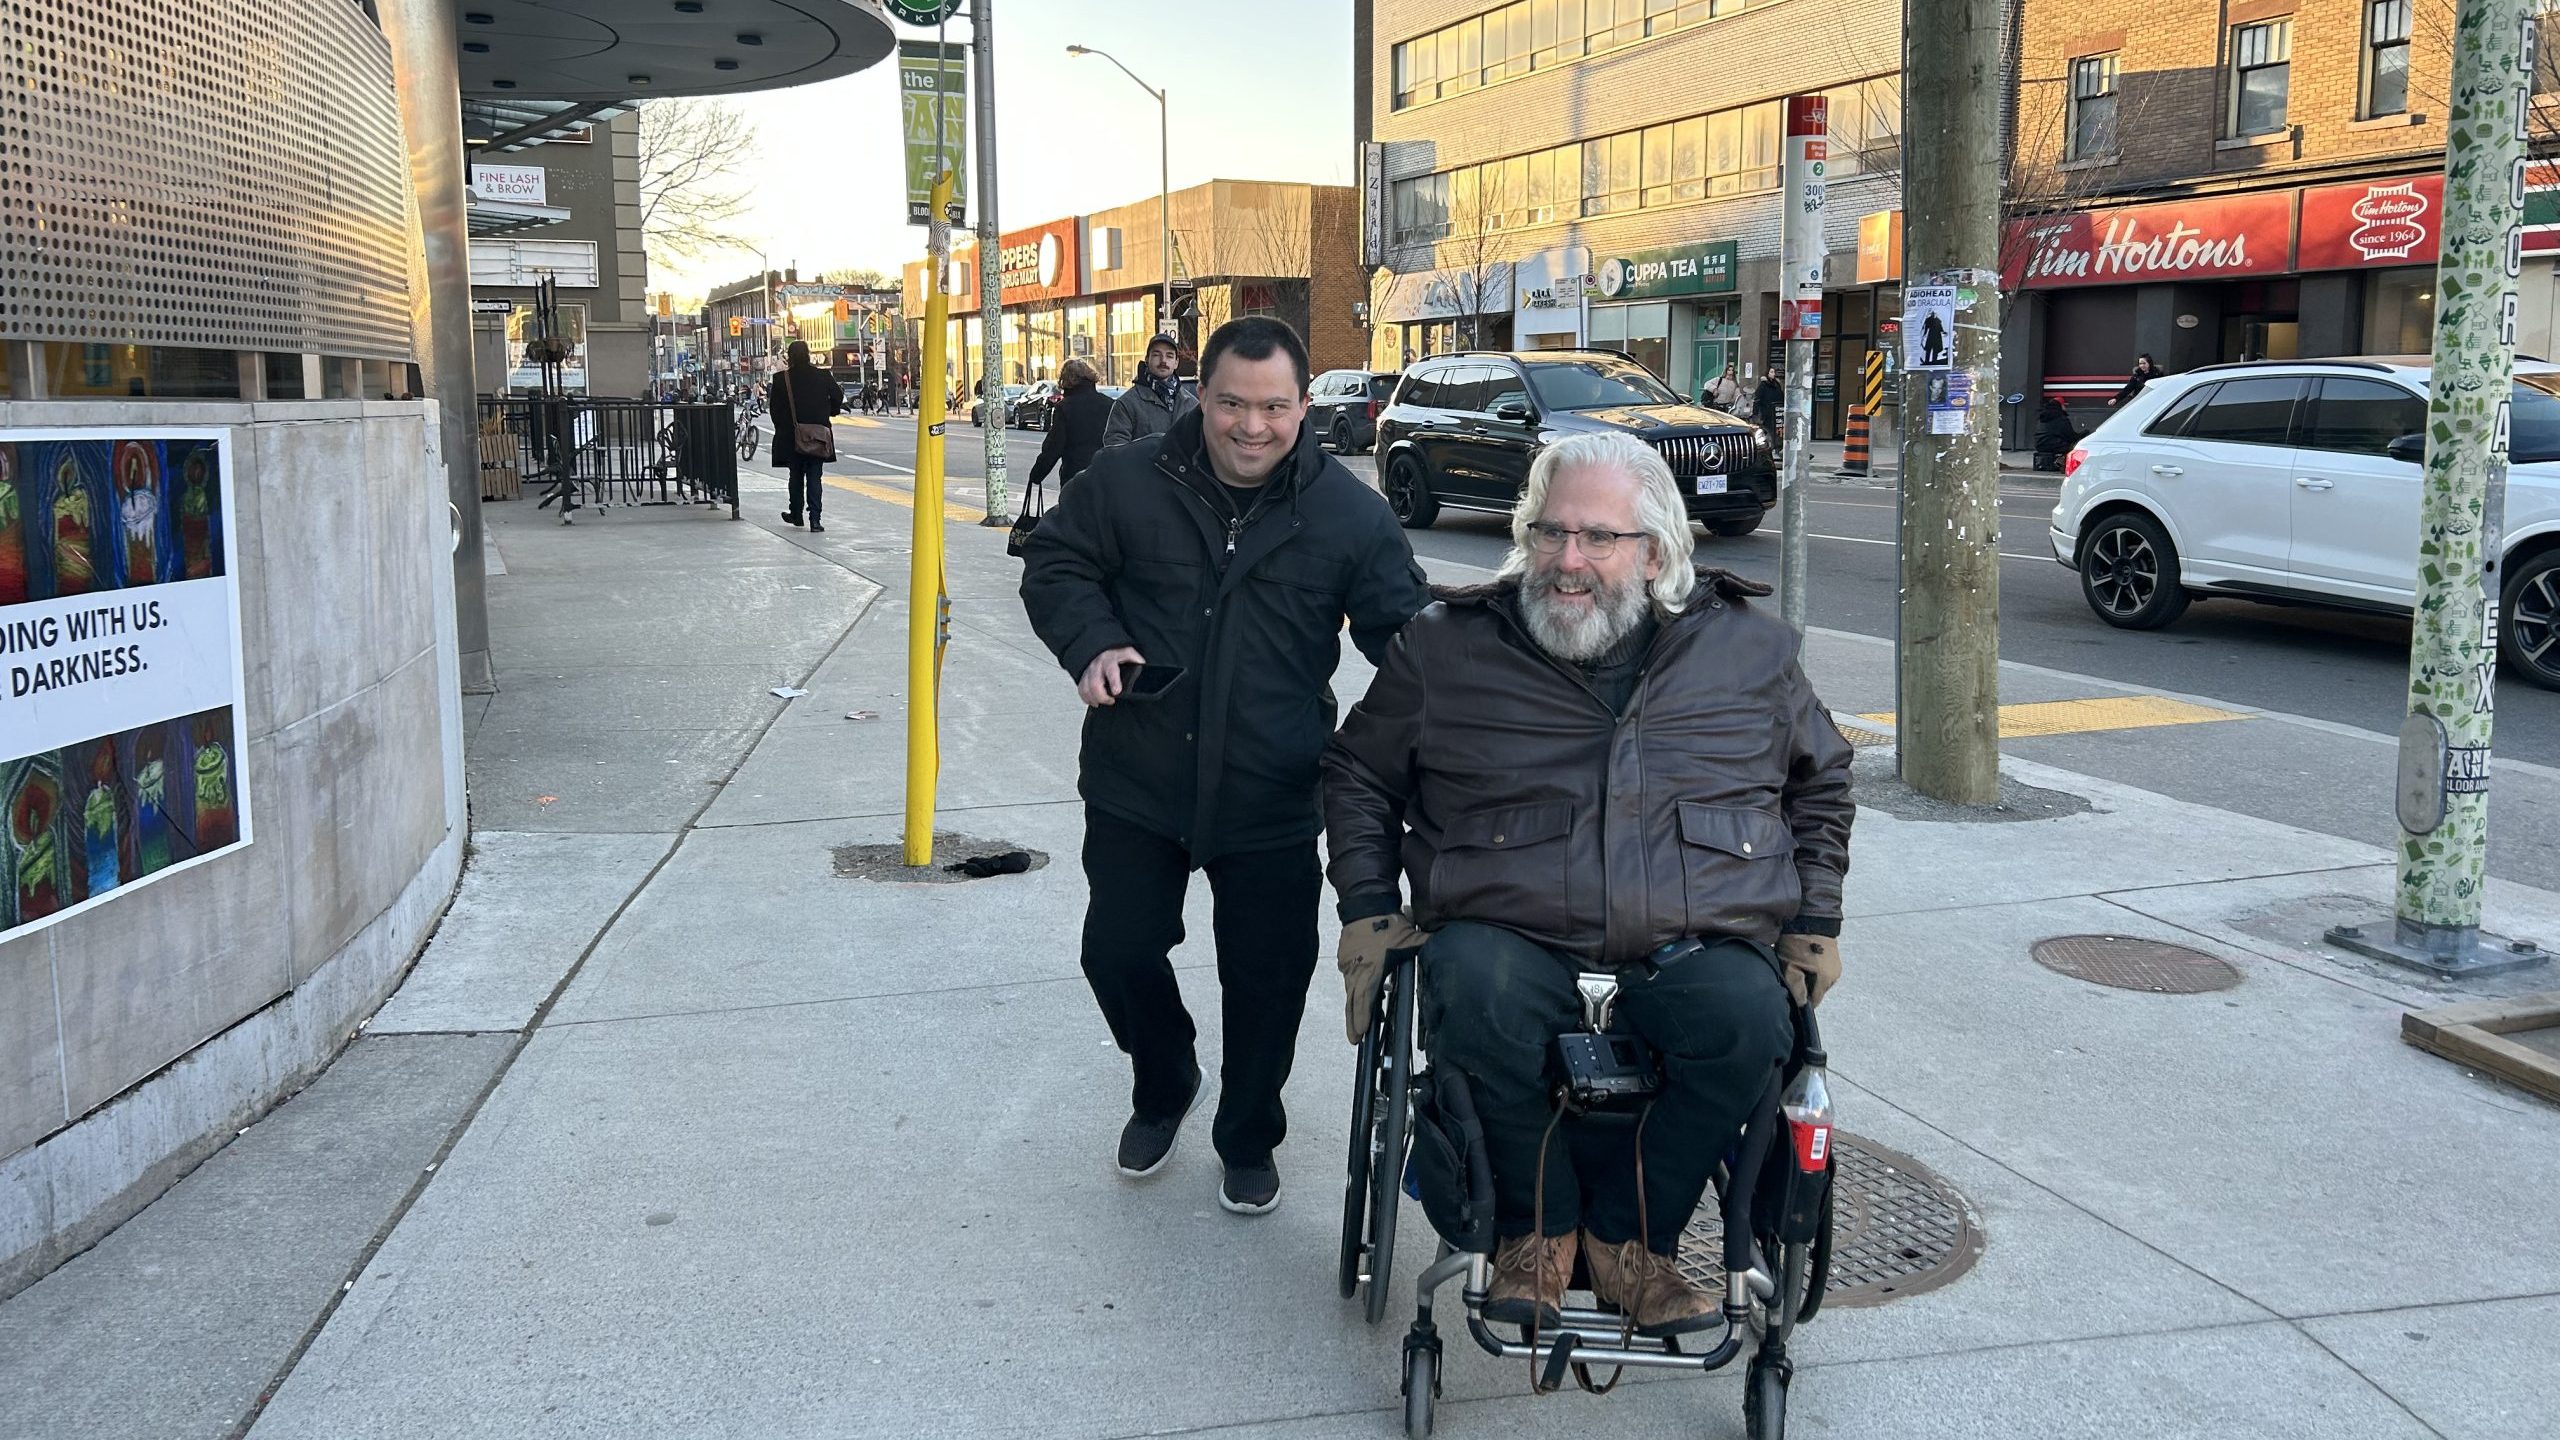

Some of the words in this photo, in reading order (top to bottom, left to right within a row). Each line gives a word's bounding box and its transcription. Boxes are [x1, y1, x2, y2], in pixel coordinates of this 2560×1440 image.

[904, 71, 935, 88] the
[479, 172, 506, 183] FINE
[509, 173, 540, 184] LASH
[485, 183, 494, 193] &
[497, 184, 535, 194] BROW
[2359, 201, 2379, 216] Tim
[2379, 200, 2419, 215] Hortons
[2359, 233, 2386, 244] since
[2389, 229, 2416, 242] 1964
[1000, 242, 1038, 272] PPERS
[2026, 224, 2091, 279] Tim
[2094, 217, 2246, 275] Hortons
[1020, 268, 1038, 286] MART
[1625, 261, 1668, 282] CUPPA
[1670, 258, 1698, 278] TEA
[1908, 290, 1952, 298] ADIOHEAD
[987, 274, 999, 356] BLOOR
[0, 616, 58, 654] ING
[65, 605, 126, 642] WITH
[131, 600, 168, 632] US.
[12, 645, 148, 698] DARKNESS.
